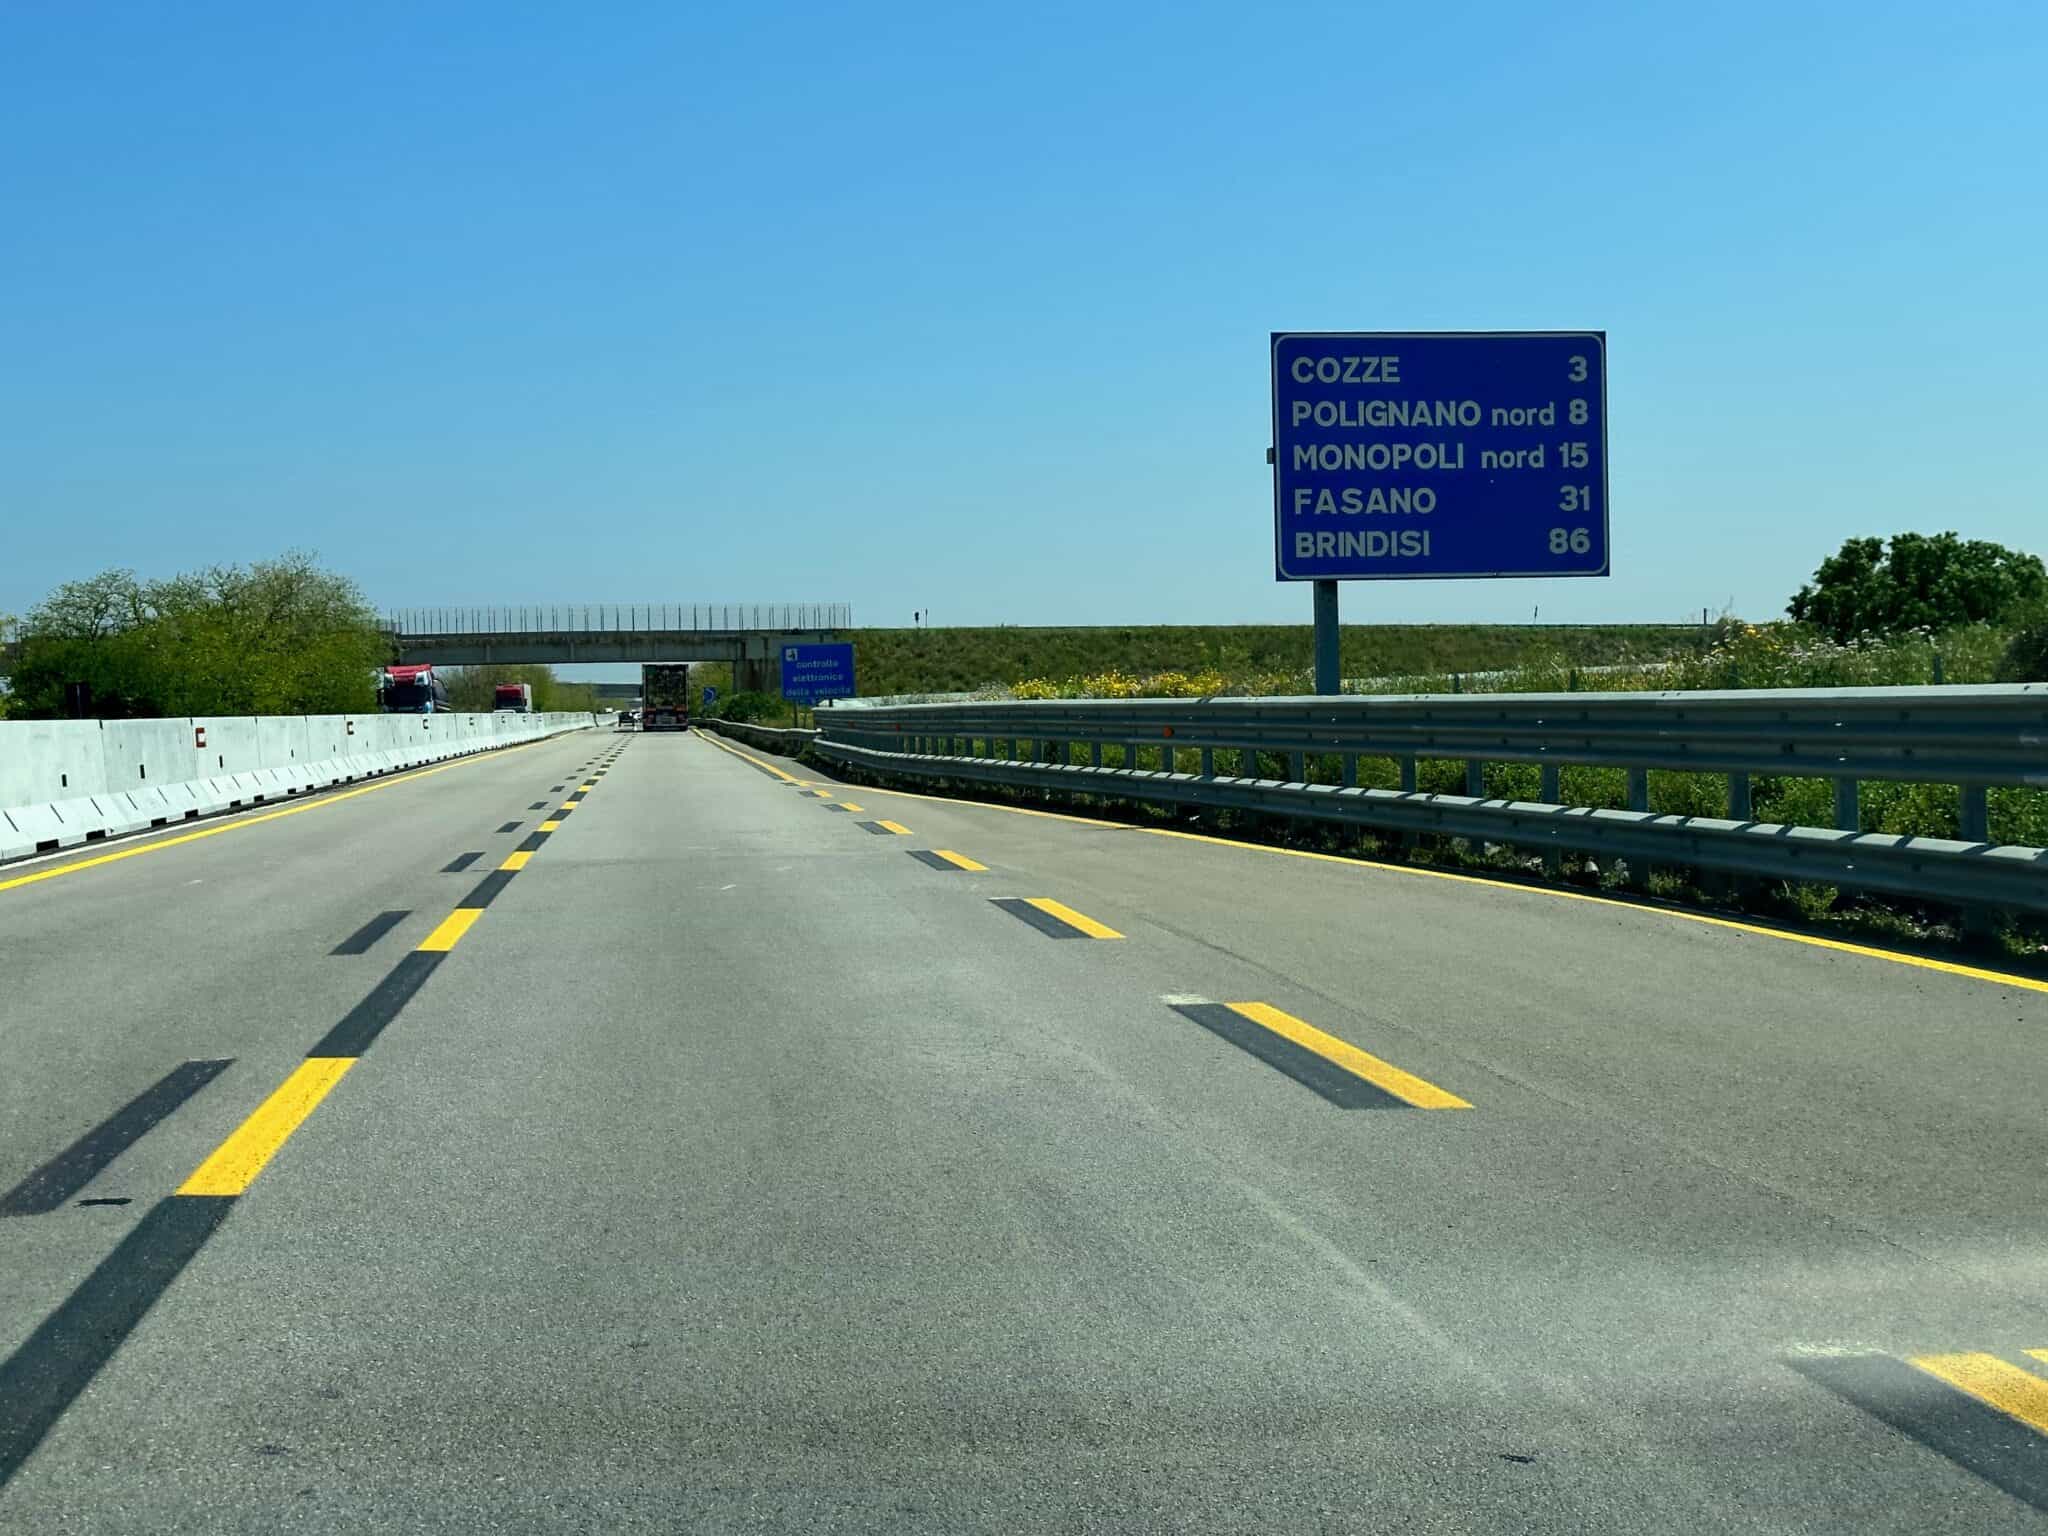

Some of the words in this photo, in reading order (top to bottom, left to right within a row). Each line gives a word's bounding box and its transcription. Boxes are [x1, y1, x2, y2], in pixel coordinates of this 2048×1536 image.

[1292, 357, 1400, 383] COZZE
[1569, 356, 1587, 381] 3
[1293, 400, 1481, 427] POLIGNANO
[1492, 402, 1554, 426] nord
[1569, 399, 1588, 424] 8
[1294, 443, 1463, 470] MONOPOLI
[1482, 444, 1544, 468] nord
[1559, 442, 1588, 468] 15
[1295, 488, 1436, 514] FASANO
[1560, 486, 1589, 511] 31
[1296, 531, 1429, 557] BRINDISI
[1550, 528, 1590, 554] 86
